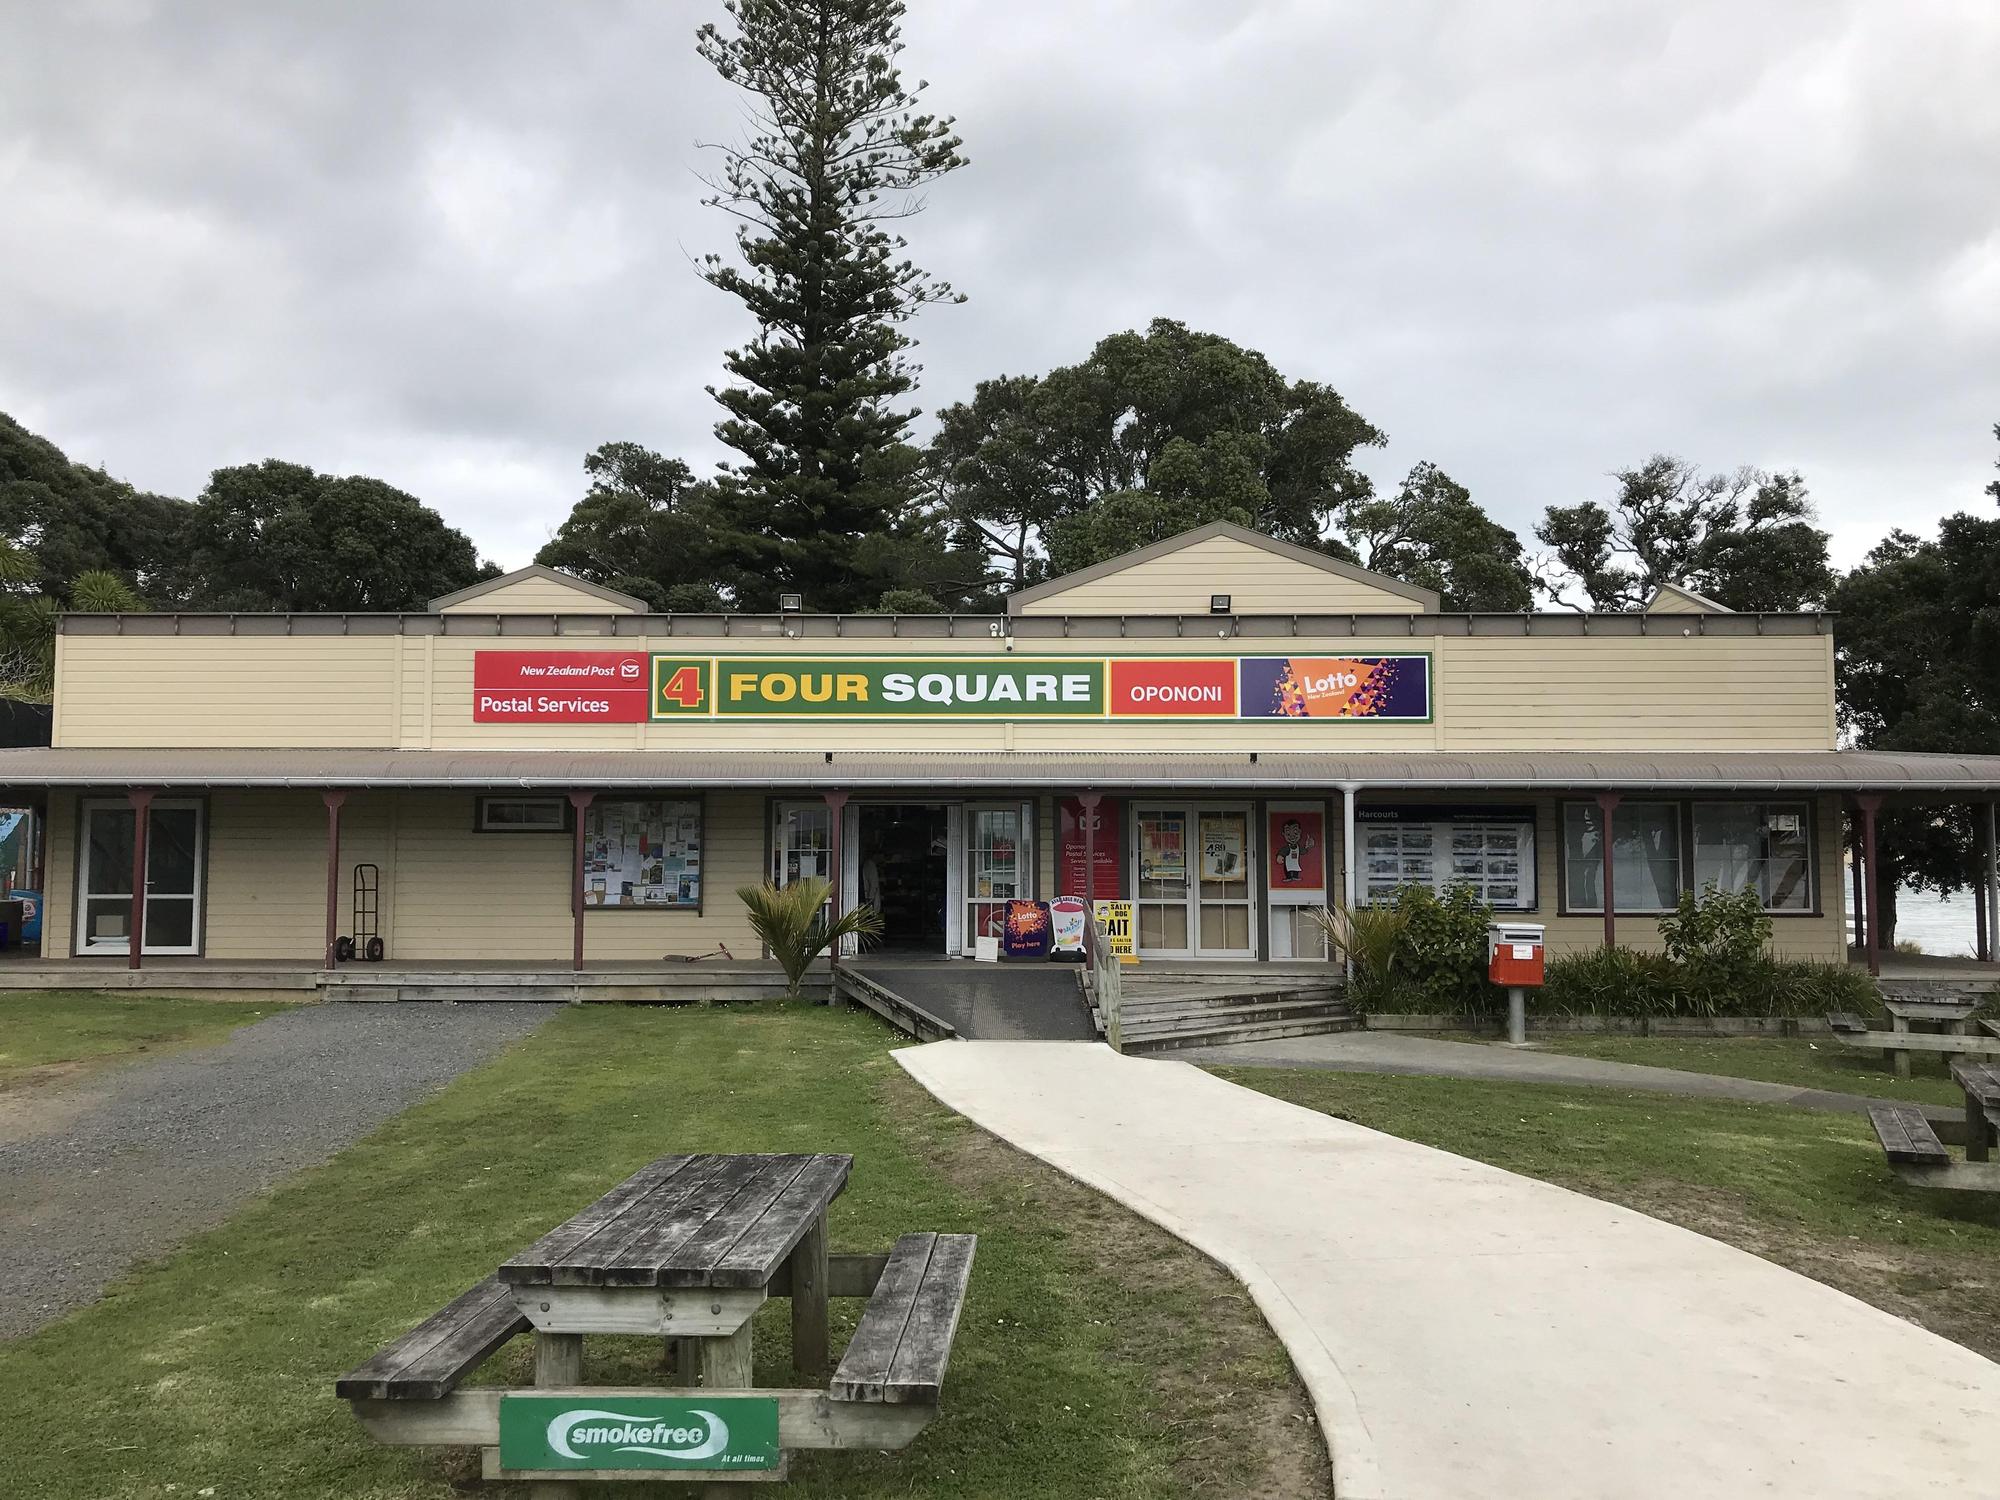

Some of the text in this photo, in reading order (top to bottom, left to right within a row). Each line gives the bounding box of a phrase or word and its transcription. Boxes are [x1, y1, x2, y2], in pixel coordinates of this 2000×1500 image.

[520, 665, 615, 676] New Zealand Post
[663, 667, 703, 708] 4
[730, 673, 1092, 705] FOUR SQUARE
[1303, 672, 1358, 694] Lotto
[1130, 685, 1223, 703] OPONONI
[1321, 689, 1345, 698] Zealand
[480, 697, 609, 713] Postal Services
[1358, 810, 1399, 819] Harcourts
[1017, 911, 1038, 920] Lotto
[1115, 945, 1132, 954] HERE
[571, 1422, 703, 1444] smokefree
[721, 1454, 765, 1463] At all times
